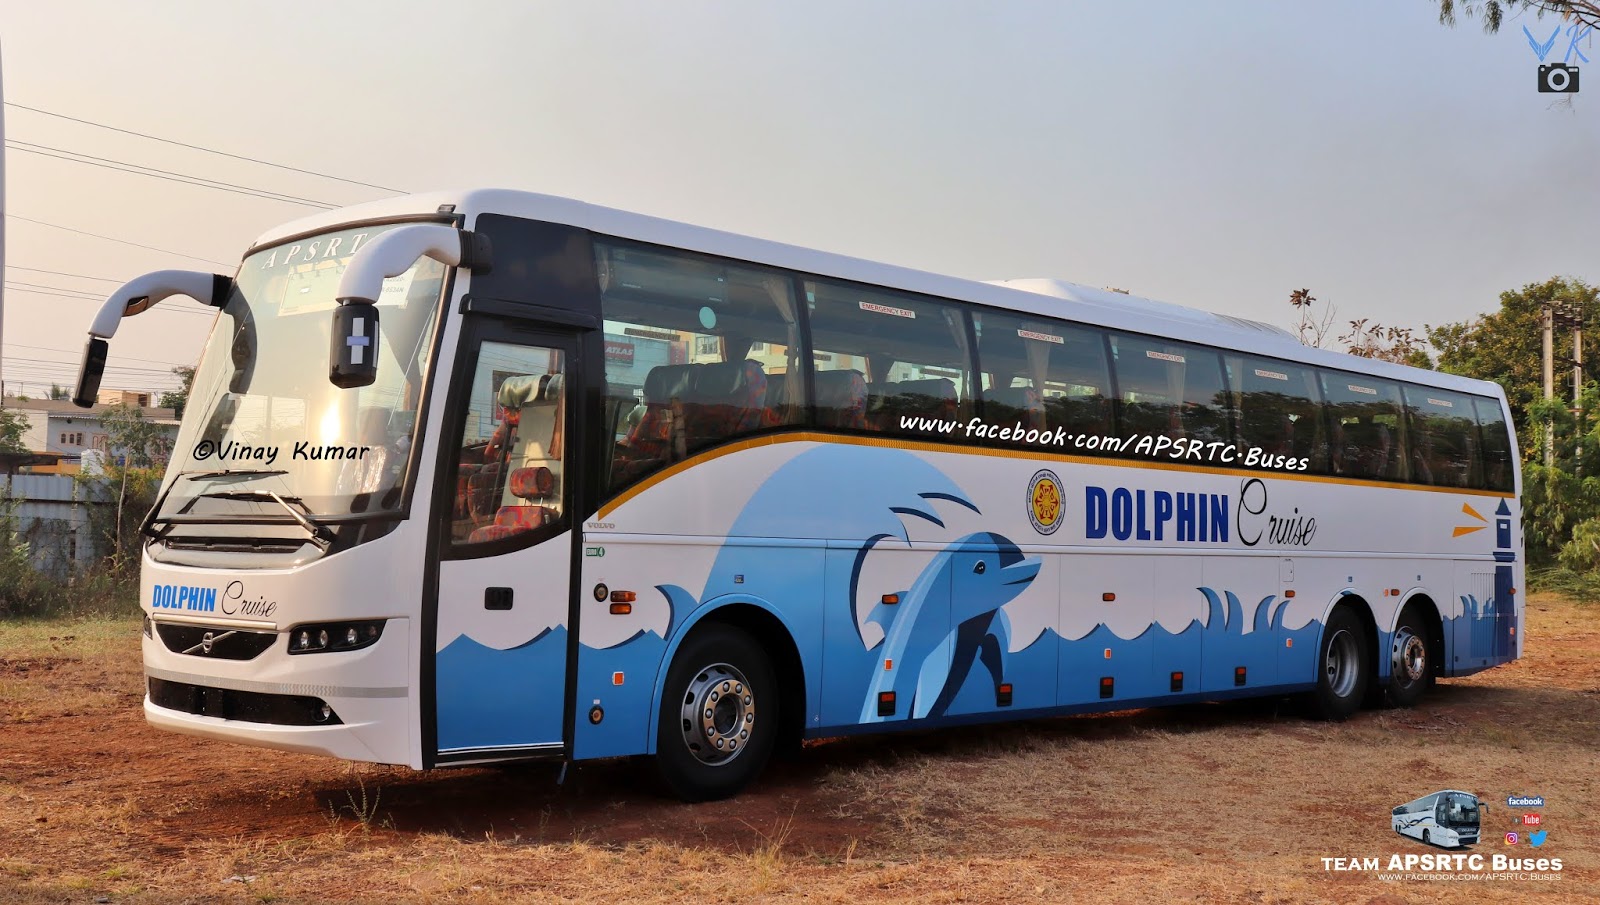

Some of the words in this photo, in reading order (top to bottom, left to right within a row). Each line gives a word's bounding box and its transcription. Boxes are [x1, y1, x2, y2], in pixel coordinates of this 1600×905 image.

[861, 302, 898, 315] EMERGENCY
[1020, 330, 1050, 341] EMERGENCY
[605, 346, 633, 356] ATLAS
[1085, 486, 1229, 543] DOLPHIN
[1237, 477, 1318, 547] Cruise
[152, 584, 217, 612] DOLPHIN
[221, 580, 278, 618] Cruise
